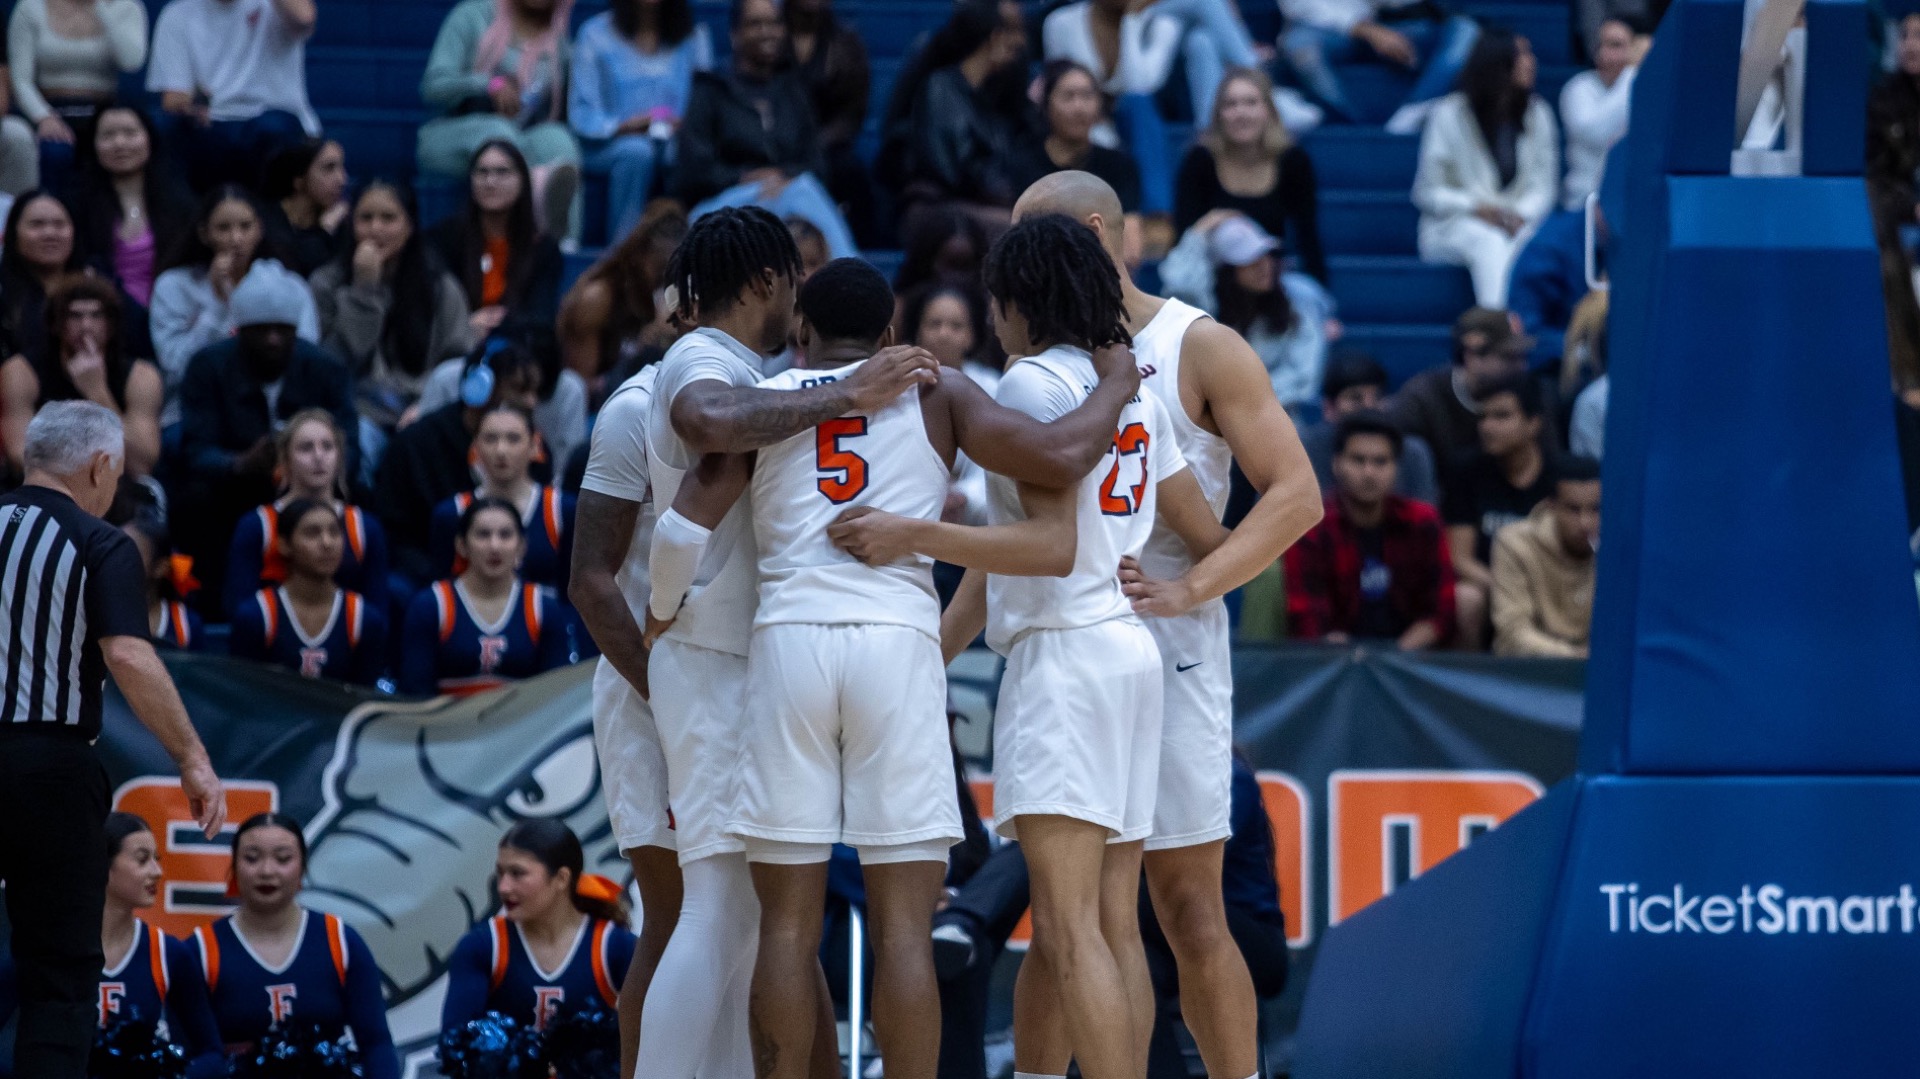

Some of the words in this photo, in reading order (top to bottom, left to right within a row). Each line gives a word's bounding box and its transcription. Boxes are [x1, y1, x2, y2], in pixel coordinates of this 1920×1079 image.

[815, 415, 869, 505] 5
[1099, 421, 1150, 516] 23
[478, 635, 508, 672] F
[1599, 883, 1920, 934] TicketSmart
[97, 981, 126, 1030] F
[264, 982, 298, 1032] F
[533, 985, 566, 1033] F
